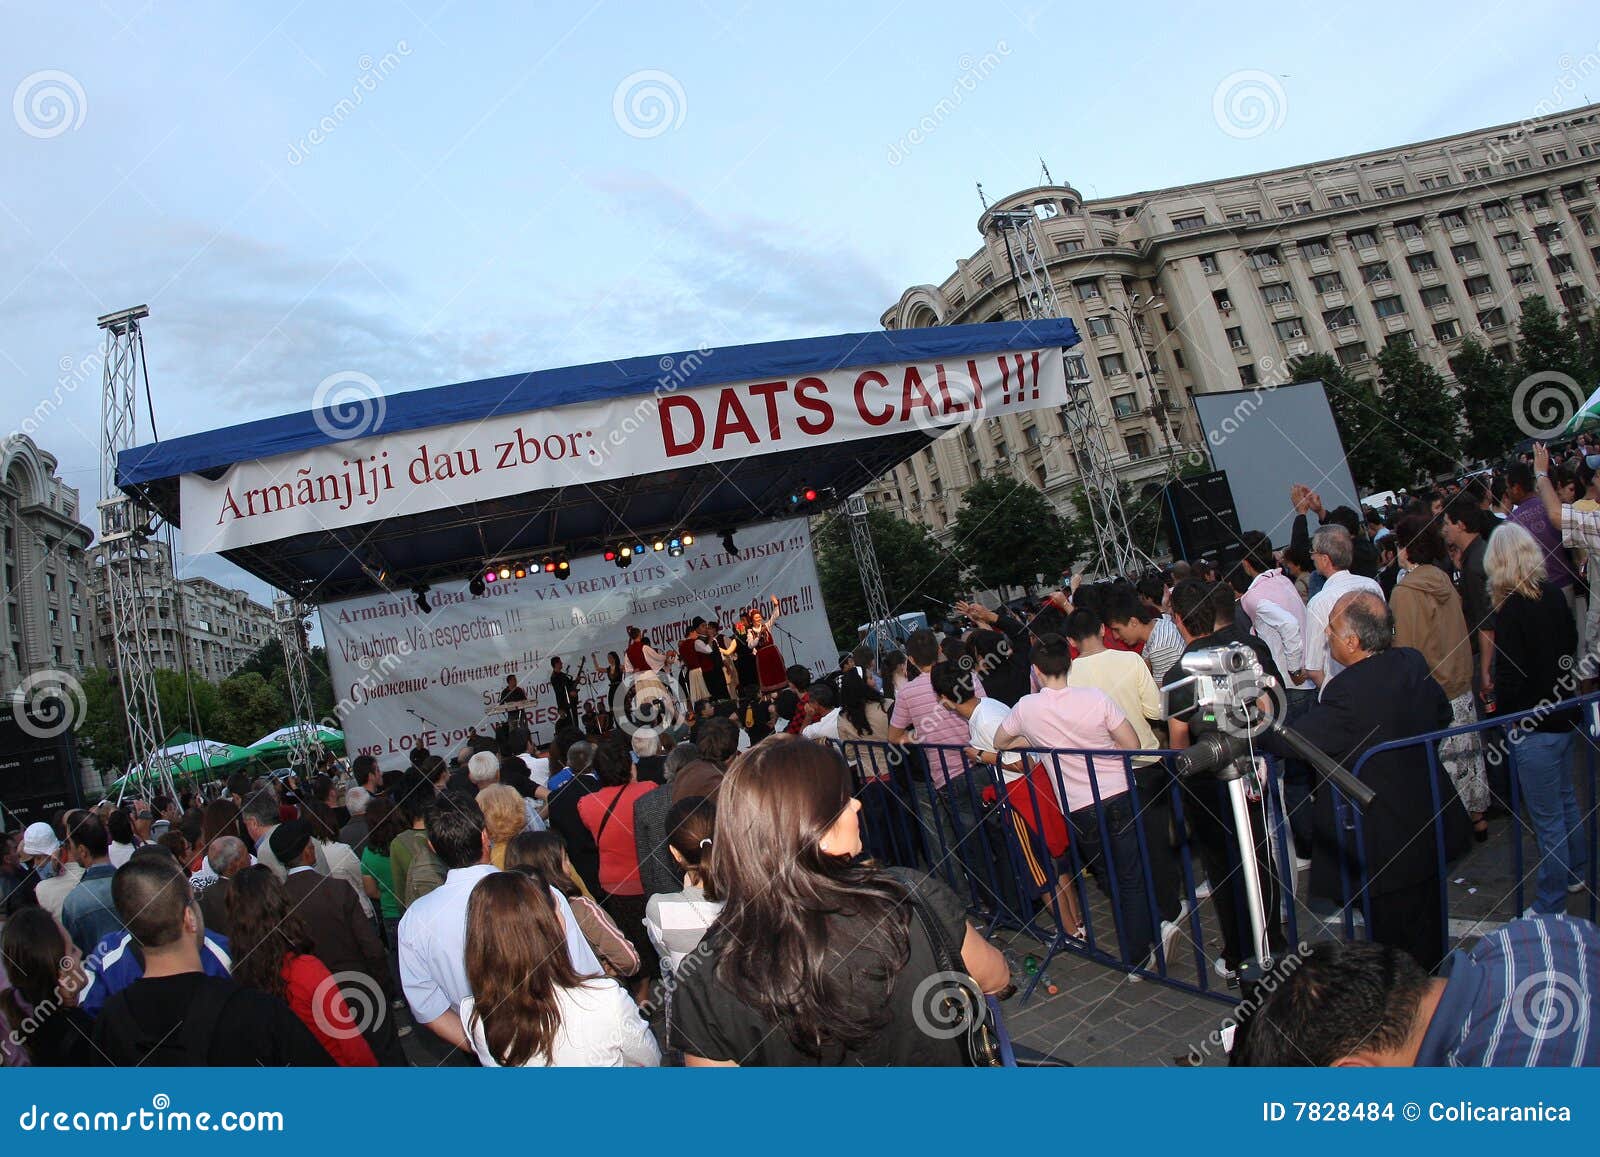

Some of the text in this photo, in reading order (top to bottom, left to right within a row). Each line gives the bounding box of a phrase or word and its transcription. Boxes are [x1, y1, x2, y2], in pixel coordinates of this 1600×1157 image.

[408, 445, 482, 485] dau
[494, 428, 596, 470] zbor:
[657, 376, 835, 458] DATS
[853, 360, 984, 426] CALI
[997, 351, 1040, 405] !!!
[432, 591, 465, 607] dau
[564, 575, 616, 596] VREM
[620, 565, 665, 585] TUTS
[431, 616, 503, 650] respectăm
[358, 744, 383, 757] we
